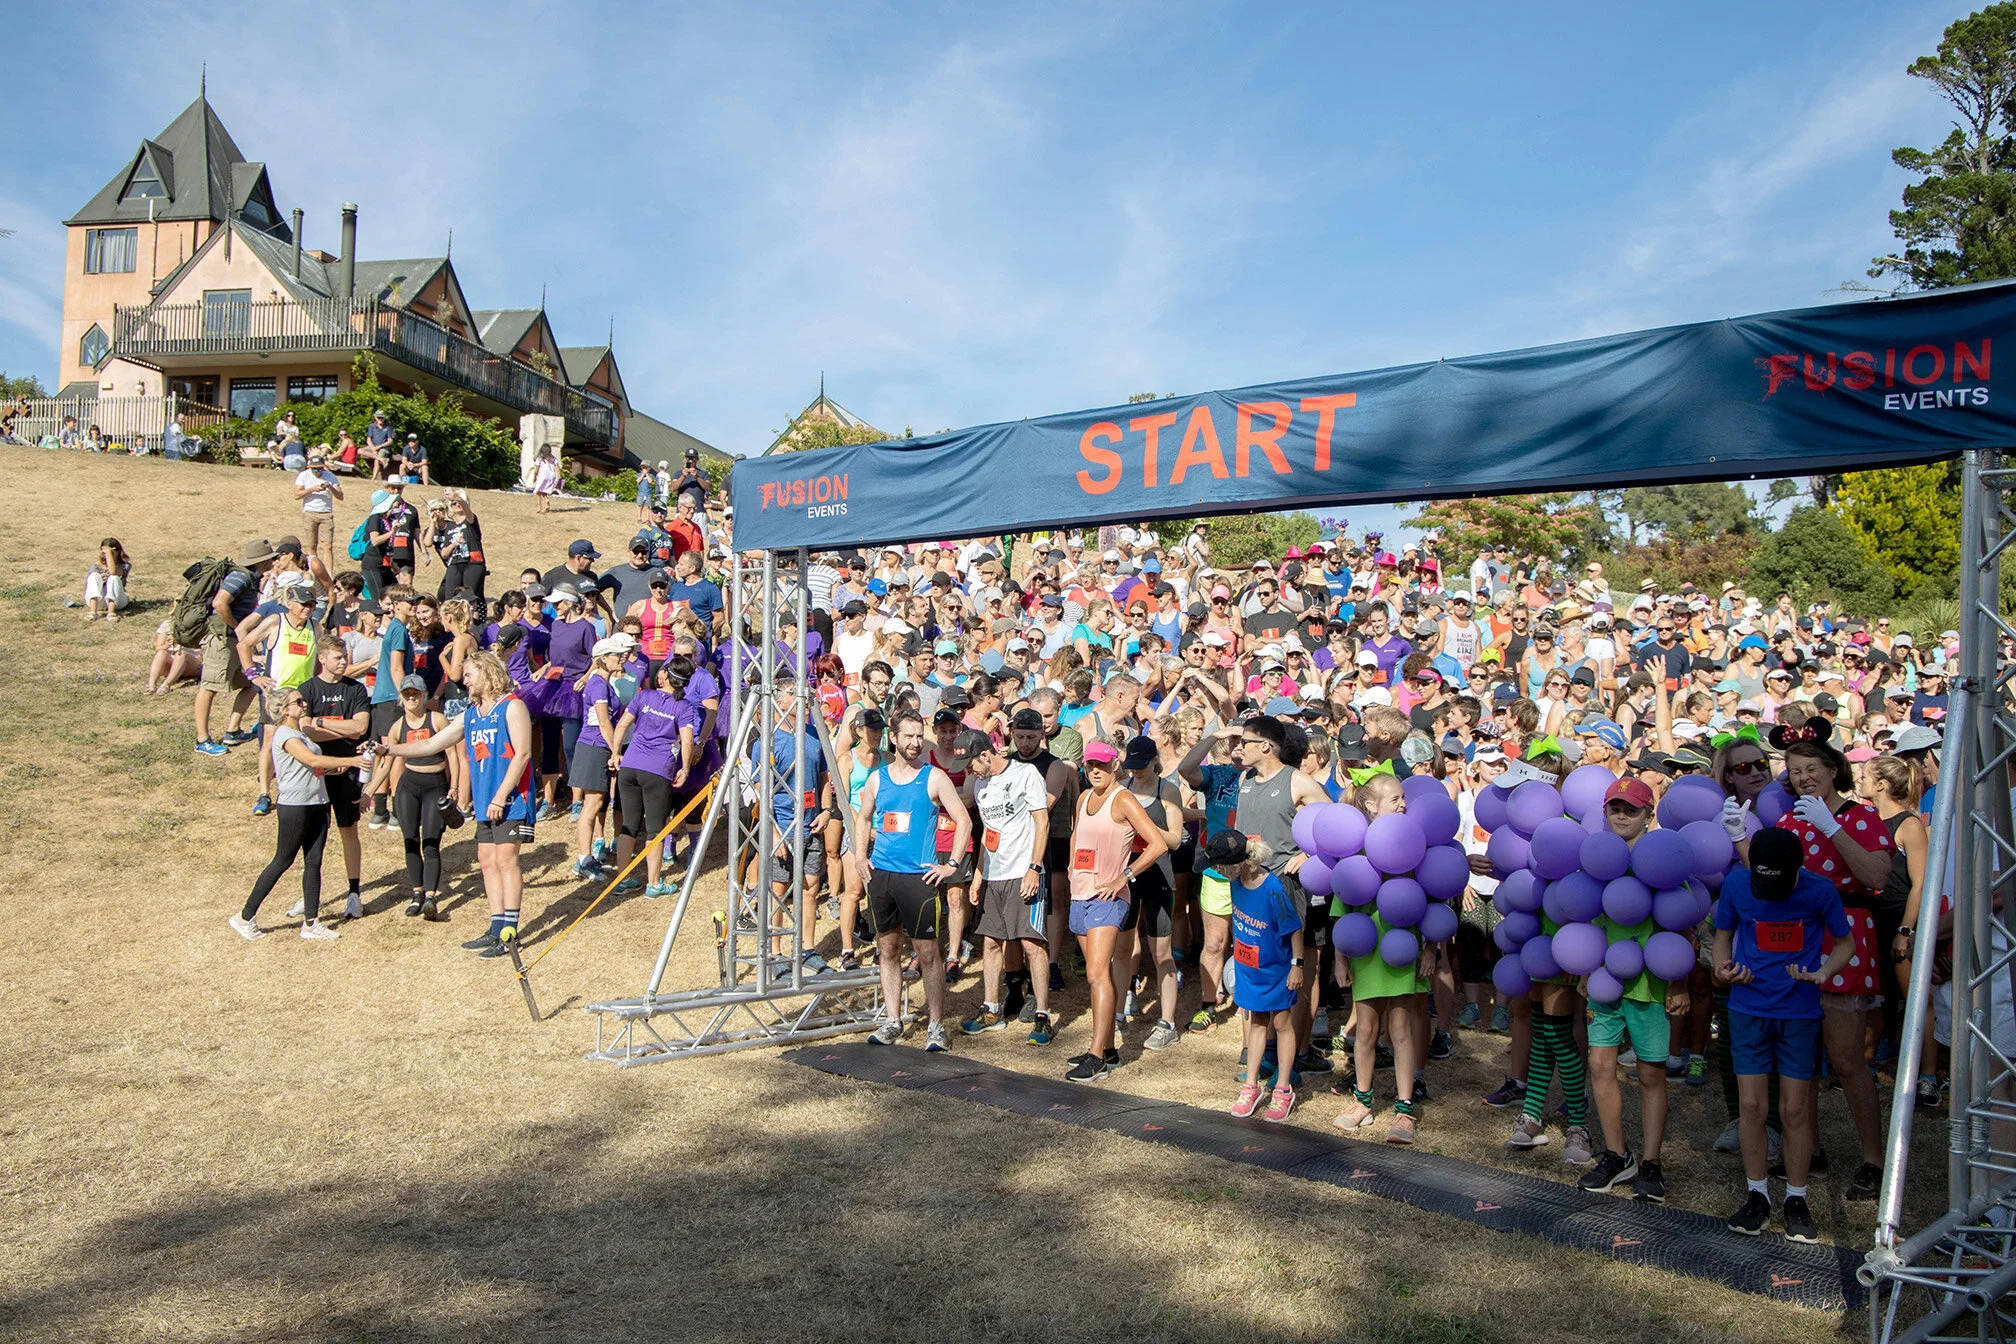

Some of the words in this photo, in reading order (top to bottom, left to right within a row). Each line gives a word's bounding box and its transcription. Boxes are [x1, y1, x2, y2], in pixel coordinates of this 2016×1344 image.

[1754, 339, 1991, 401] FUSION
[1884, 387, 1988, 410] EVENTS
[1076, 392, 1357, 495] START
[757, 473, 848, 513] FUSION
[808, 503, 848, 518] EVENTS
[1457, 646, 1472, 654] LIKE
[471, 728, 498, 745] EAST
[1769, 930, 1793, 942] 287
